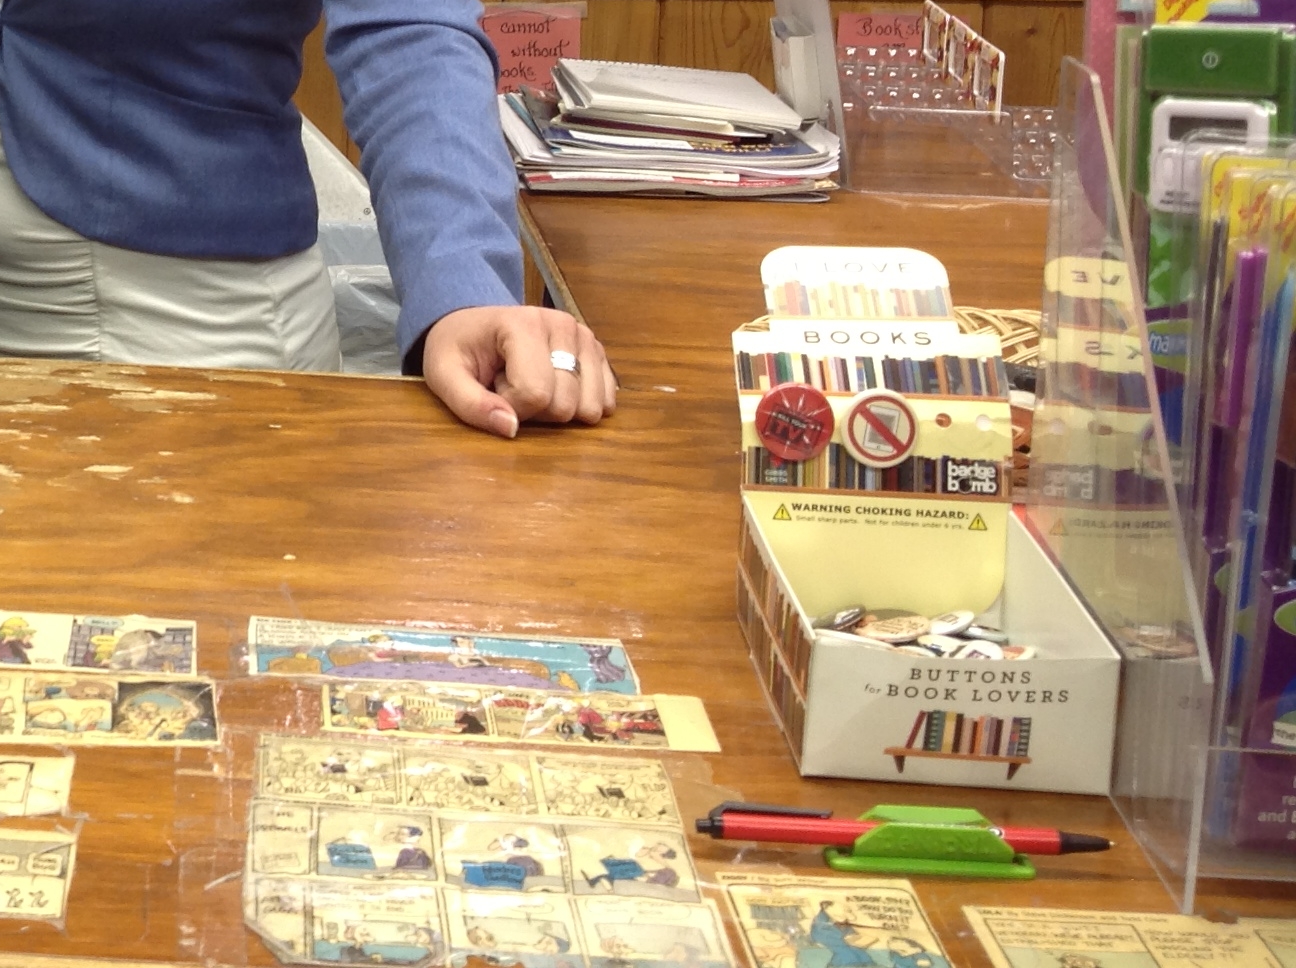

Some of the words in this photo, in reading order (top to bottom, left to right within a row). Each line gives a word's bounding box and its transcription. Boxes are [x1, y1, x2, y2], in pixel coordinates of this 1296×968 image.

[500, 17, 557, 34] cannot
[511, 39, 570, 58] without
[823, 262, 914, 275] LOVE
[804, 330, 933, 347] BOOKS
[947, 461, 996, 480] badge
[792, 502, 851, 514] WARNING
[856, 505, 912, 517] CHOKING
[916, 509, 970, 520] HAZARD:
[910, 667, 1032, 685] BUTTONS
[864, 682, 882, 695] for
[887, 683, 958, 701] BOOK
[971, 687, 1071, 704] LOVERS
[1257, 809, 1287, 823] and
